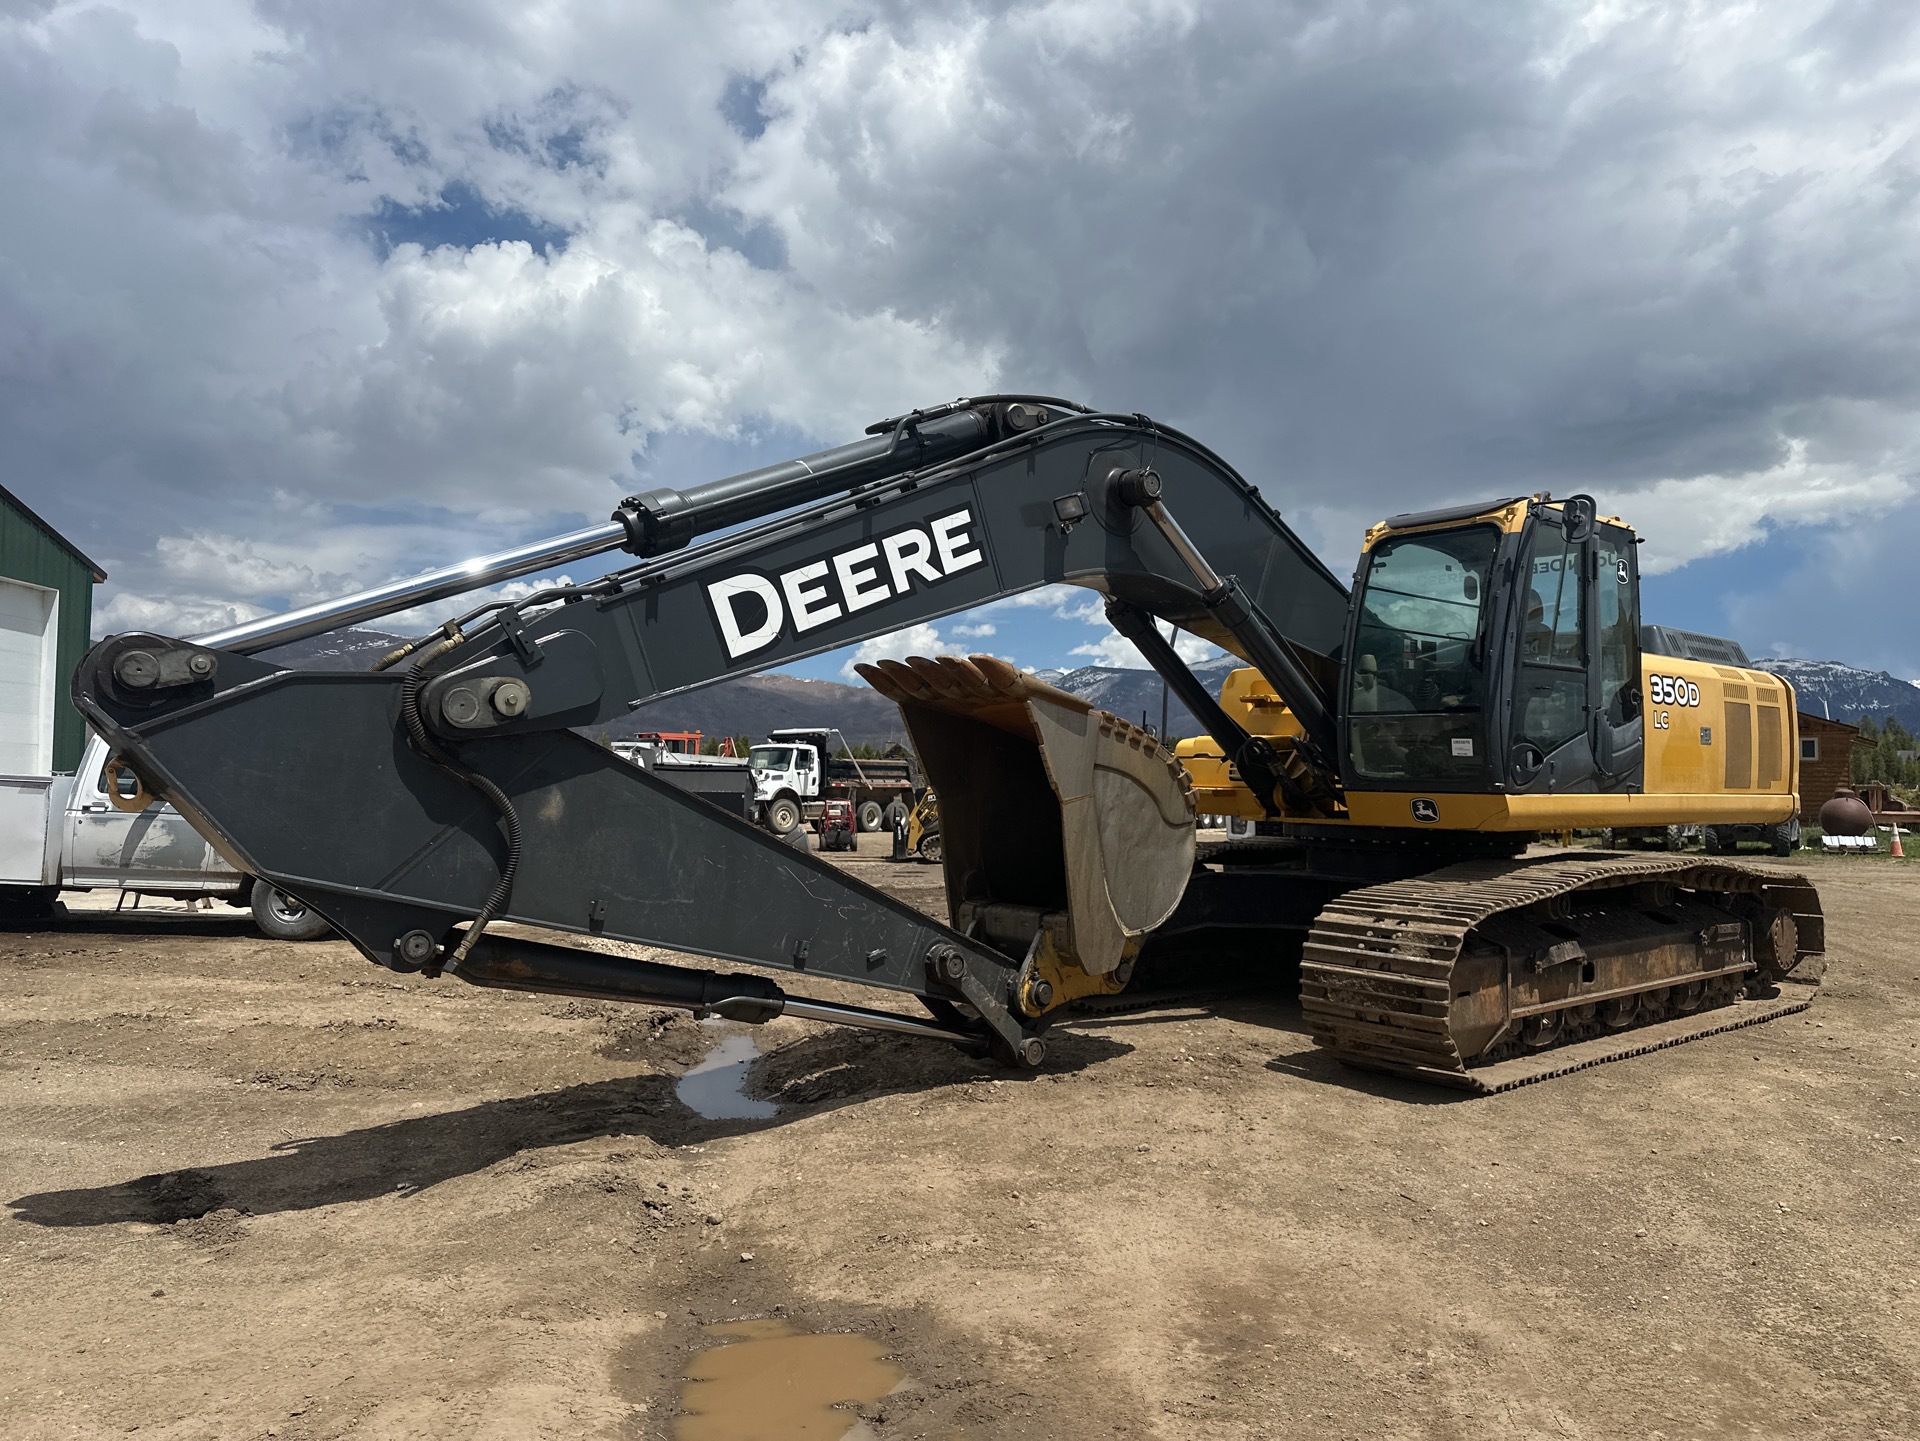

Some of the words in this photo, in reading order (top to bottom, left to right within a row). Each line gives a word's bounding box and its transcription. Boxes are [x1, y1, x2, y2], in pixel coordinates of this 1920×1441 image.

[707, 509, 982, 658] DEERE
[1649, 674, 1700, 707] 350D
[1653, 710, 1669, 729] LC
